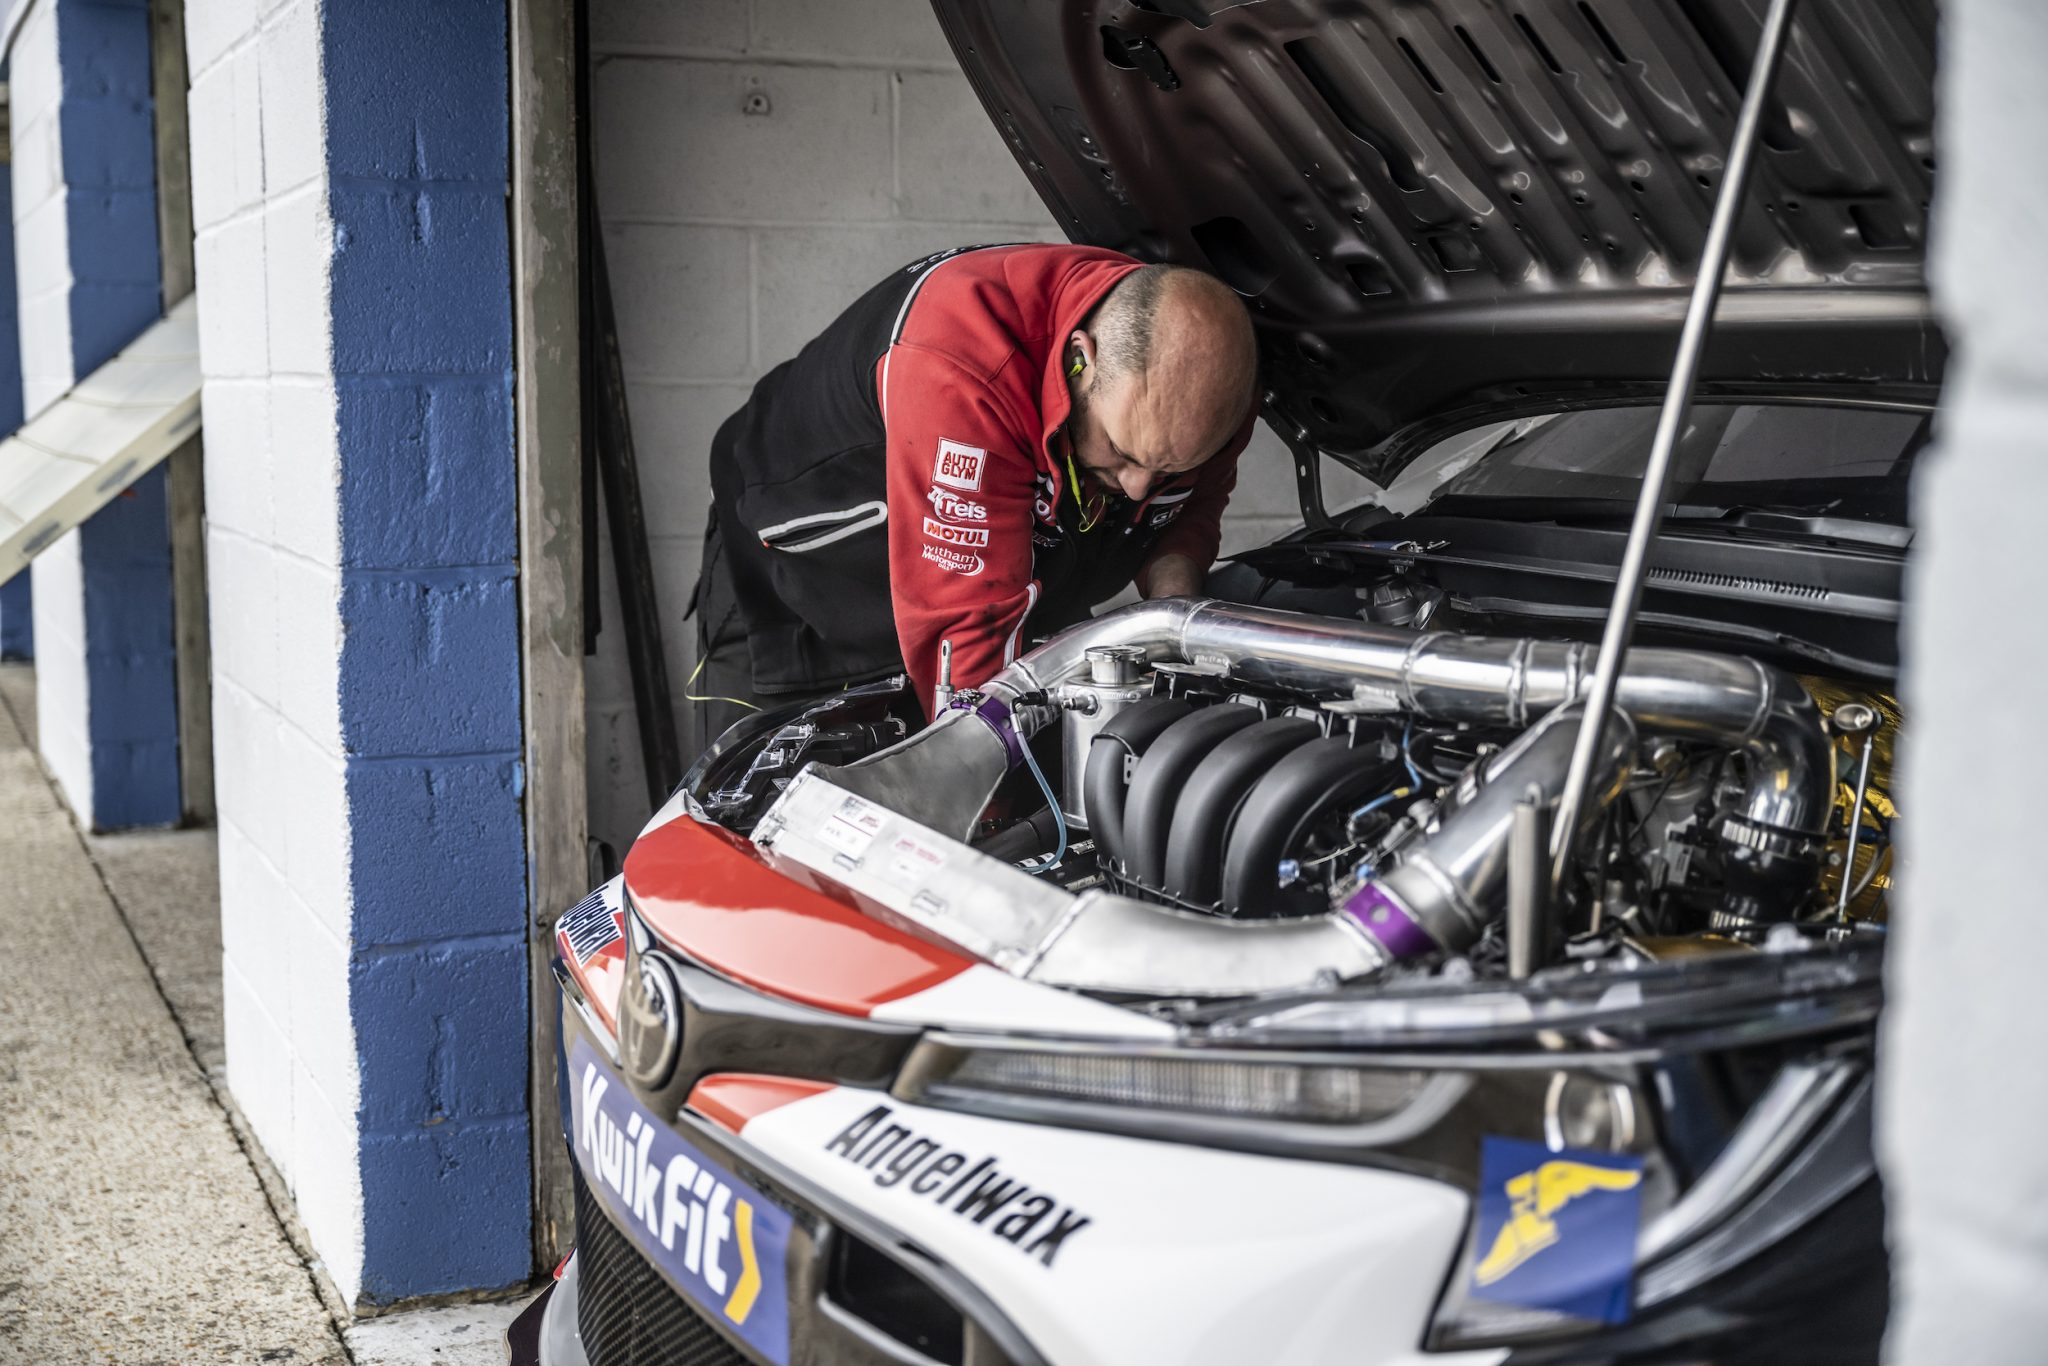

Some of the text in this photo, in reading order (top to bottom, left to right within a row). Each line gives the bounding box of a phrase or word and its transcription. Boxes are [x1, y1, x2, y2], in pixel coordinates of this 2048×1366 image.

[943, 451, 978, 470] AUTO
[941, 462, 977, 481] GLYM
[926, 522, 985, 545] MOTUL
[922, 551, 974, 571] Motorsport
[825, 1106, 1091, 1267] Angelwax
